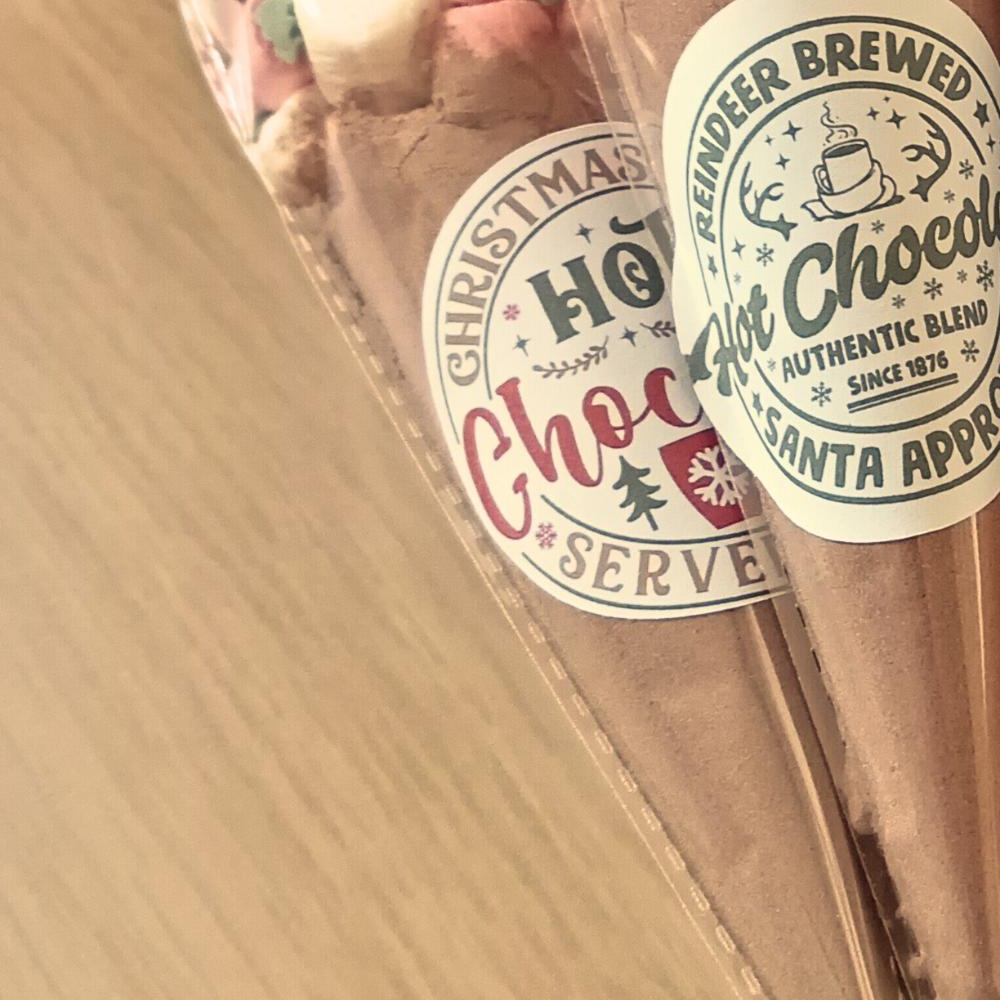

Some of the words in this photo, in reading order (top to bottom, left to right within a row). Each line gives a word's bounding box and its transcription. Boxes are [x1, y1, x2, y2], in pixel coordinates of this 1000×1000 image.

[694, 57, 791, 244] REINDEER
[793, 30, 971, 102] BREWED
[445, 143, 647, 387] CHRISTMAS
[684, 284, 774, 397] Hot
[781, 319, 917, 383] AUTHENTIC
[925, 299, 989, 342] BLEND
[847, 366, 903, 396] SINCE
[906, 351, 949, 380] 1876
[764, 408, 883, 490] SANTA
